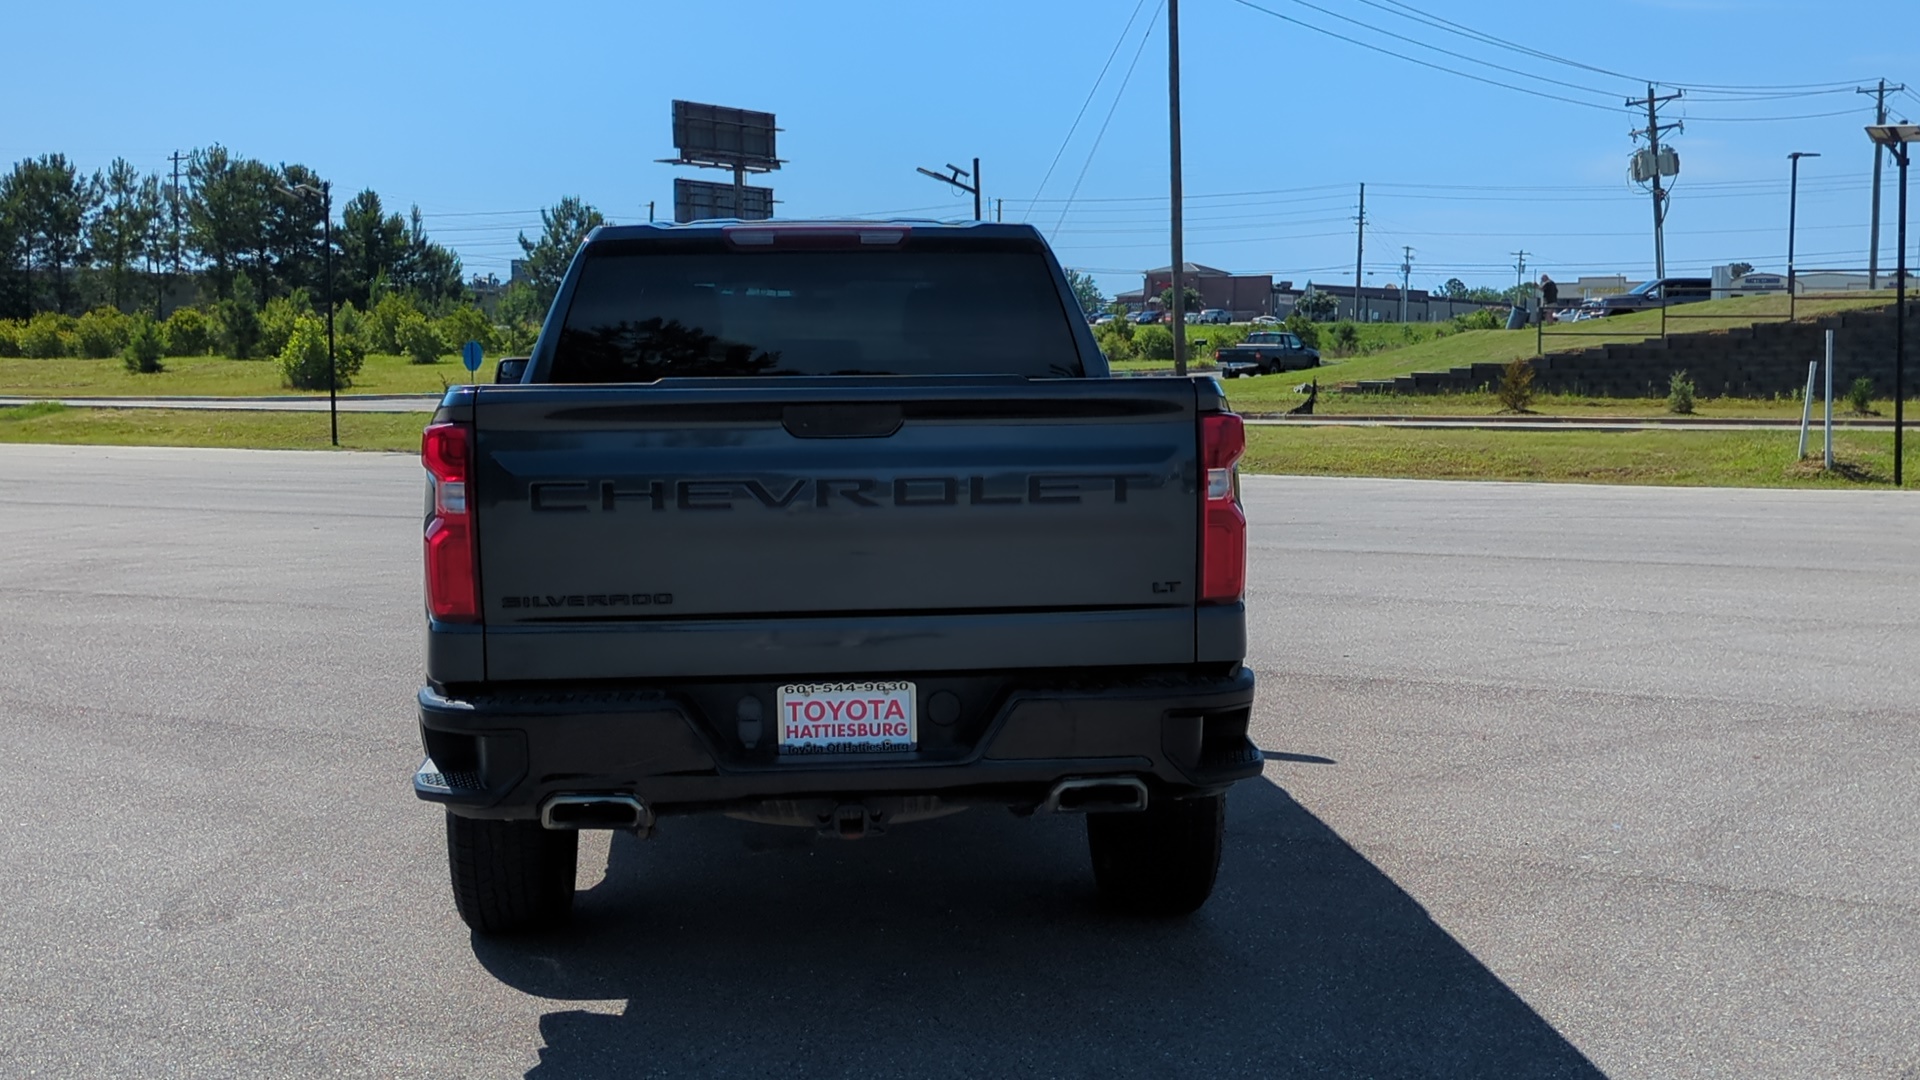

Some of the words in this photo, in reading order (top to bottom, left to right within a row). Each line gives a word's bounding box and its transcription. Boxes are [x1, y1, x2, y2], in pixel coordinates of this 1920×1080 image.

[529, 474, 1149, 512] CHEVROLET
[1152, 581, 1182, 594] LT
[502, 593, 673, 608] SILVERADO
[784, 682, 909, 694] 601-544-9630
[785, 699, 905, 722] TOYOTA
[786, 722, 908, 739] HATTIESBURG
[787, 744, 823, 754] Toyota
